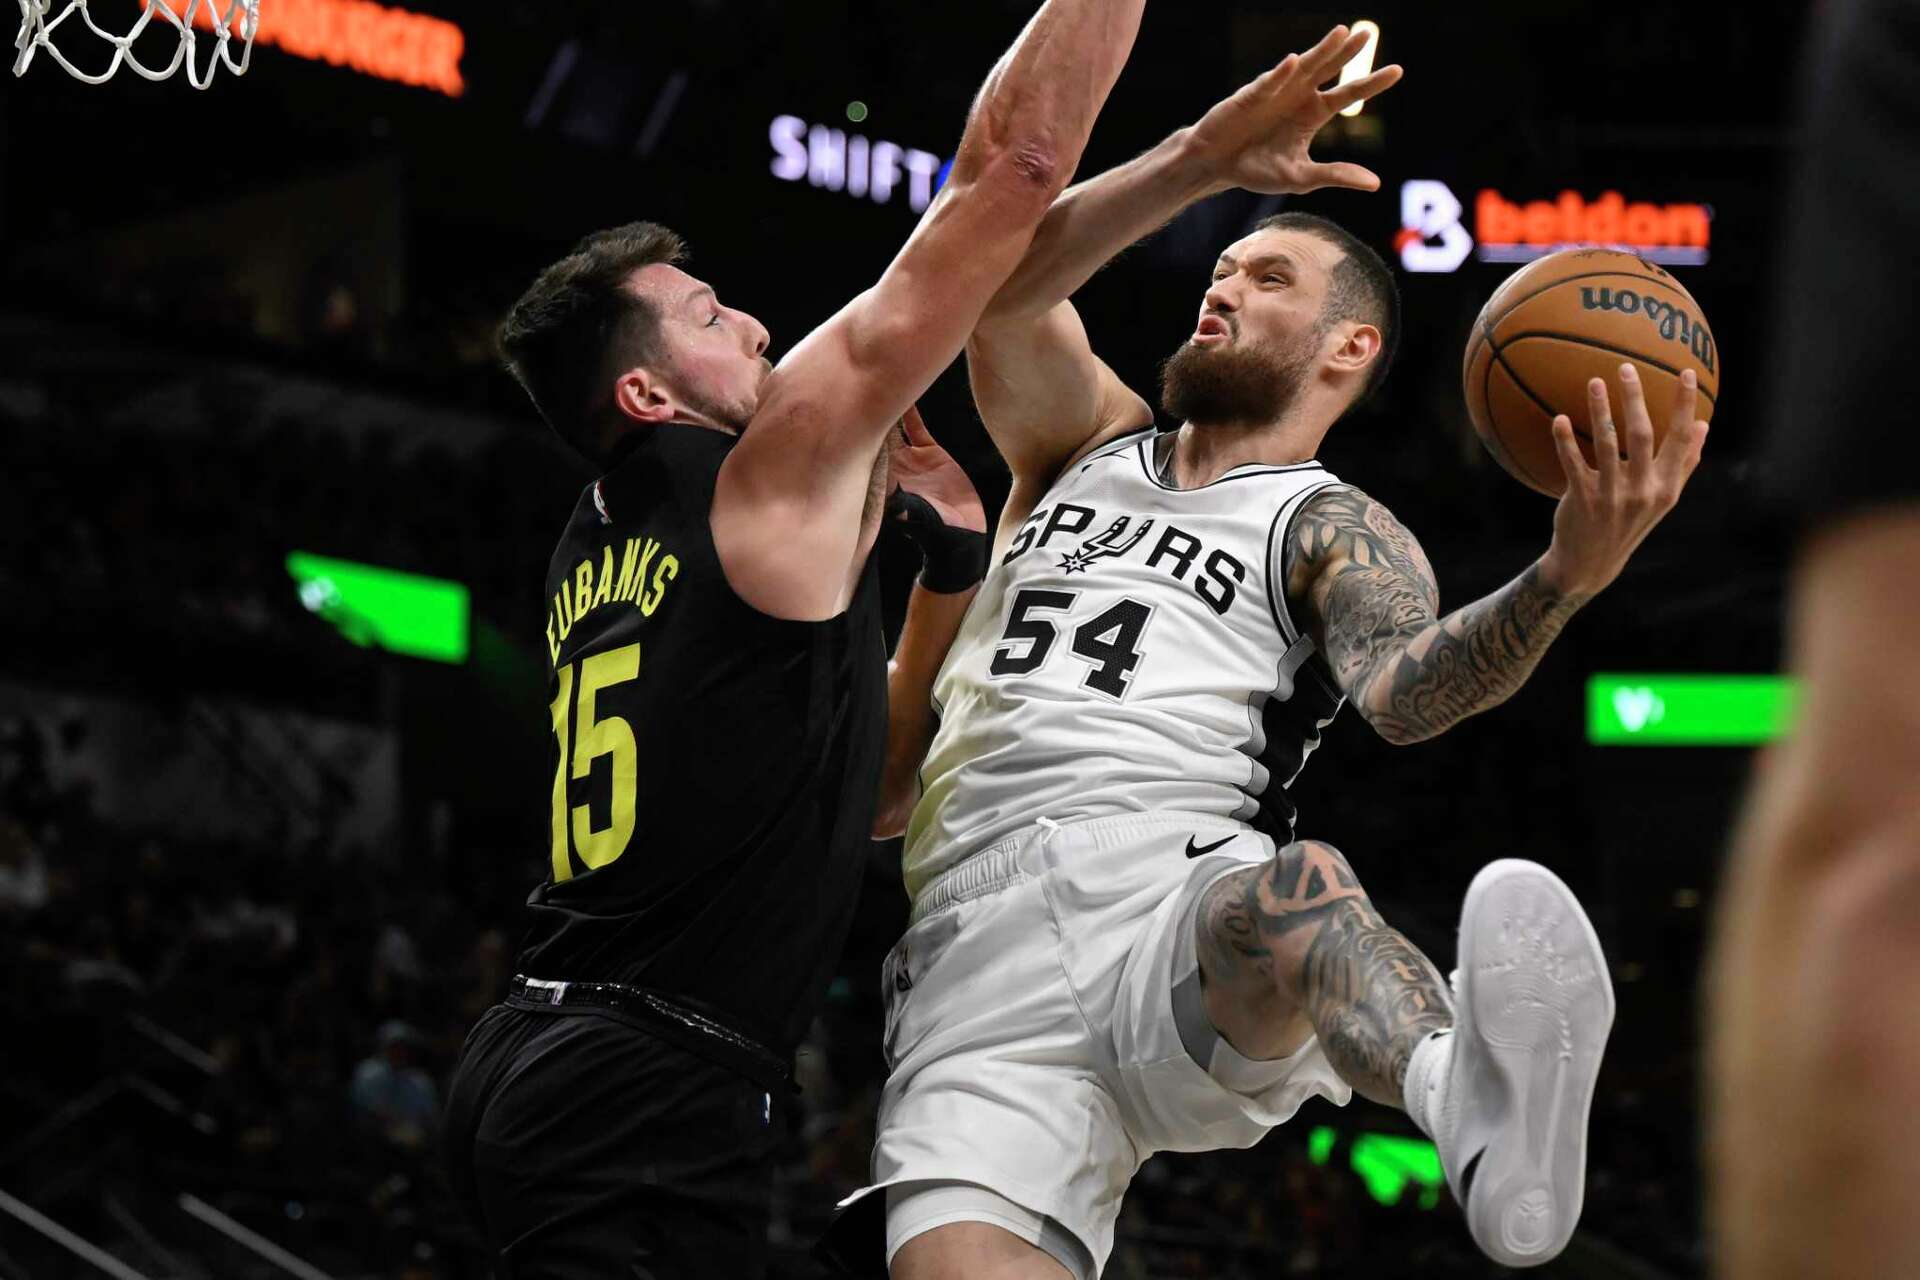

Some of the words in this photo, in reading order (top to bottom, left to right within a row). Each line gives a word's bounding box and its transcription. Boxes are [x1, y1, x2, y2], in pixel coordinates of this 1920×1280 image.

[769, 114, 955, 214] SHIFT
[1475, 189, 1710, 247] beldon
[1580, 287, 1714, 375] Wilson
[546, 537, 679, 667] EUBANKS
[1002, 503, 1246, 615] SPURS
[988, 587, 1156, 703] 54
[549, 643, 641, 884] 15
